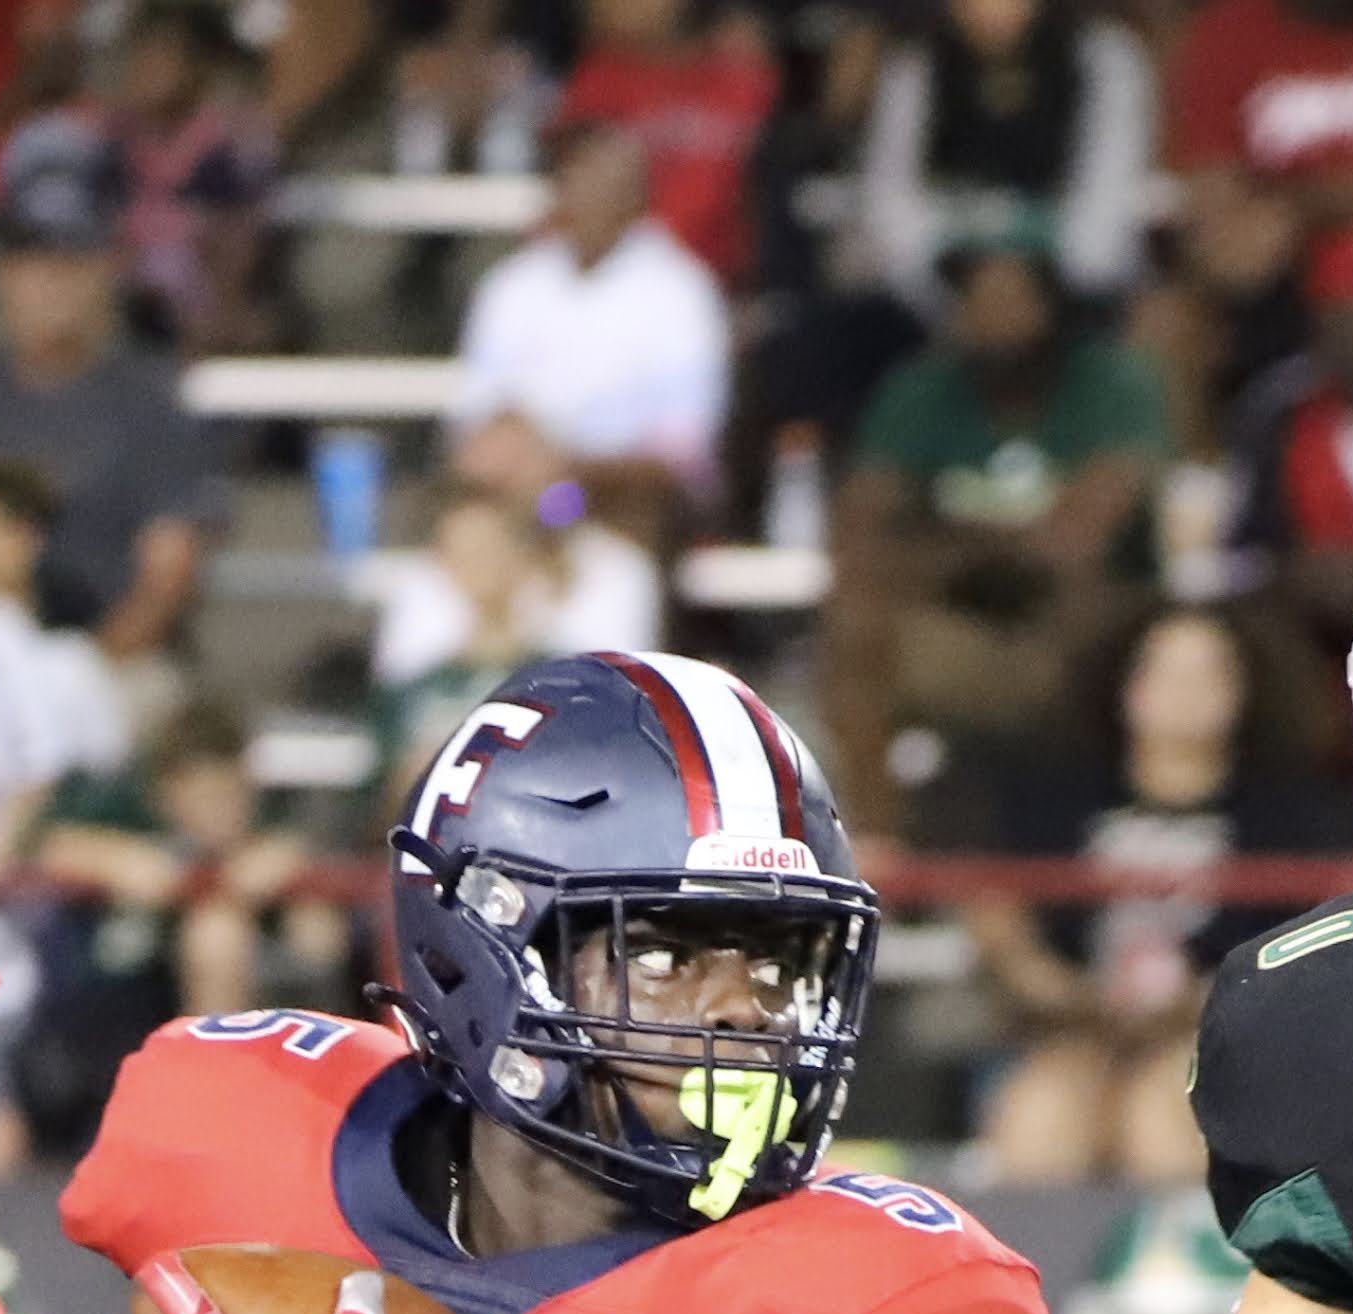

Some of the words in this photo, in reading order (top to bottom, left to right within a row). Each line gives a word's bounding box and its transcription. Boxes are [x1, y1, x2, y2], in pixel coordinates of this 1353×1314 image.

[400, 700, 552, 884] F
[710, 843, 807, 870] iddell
[808, 1172, 964, 1233] 5
